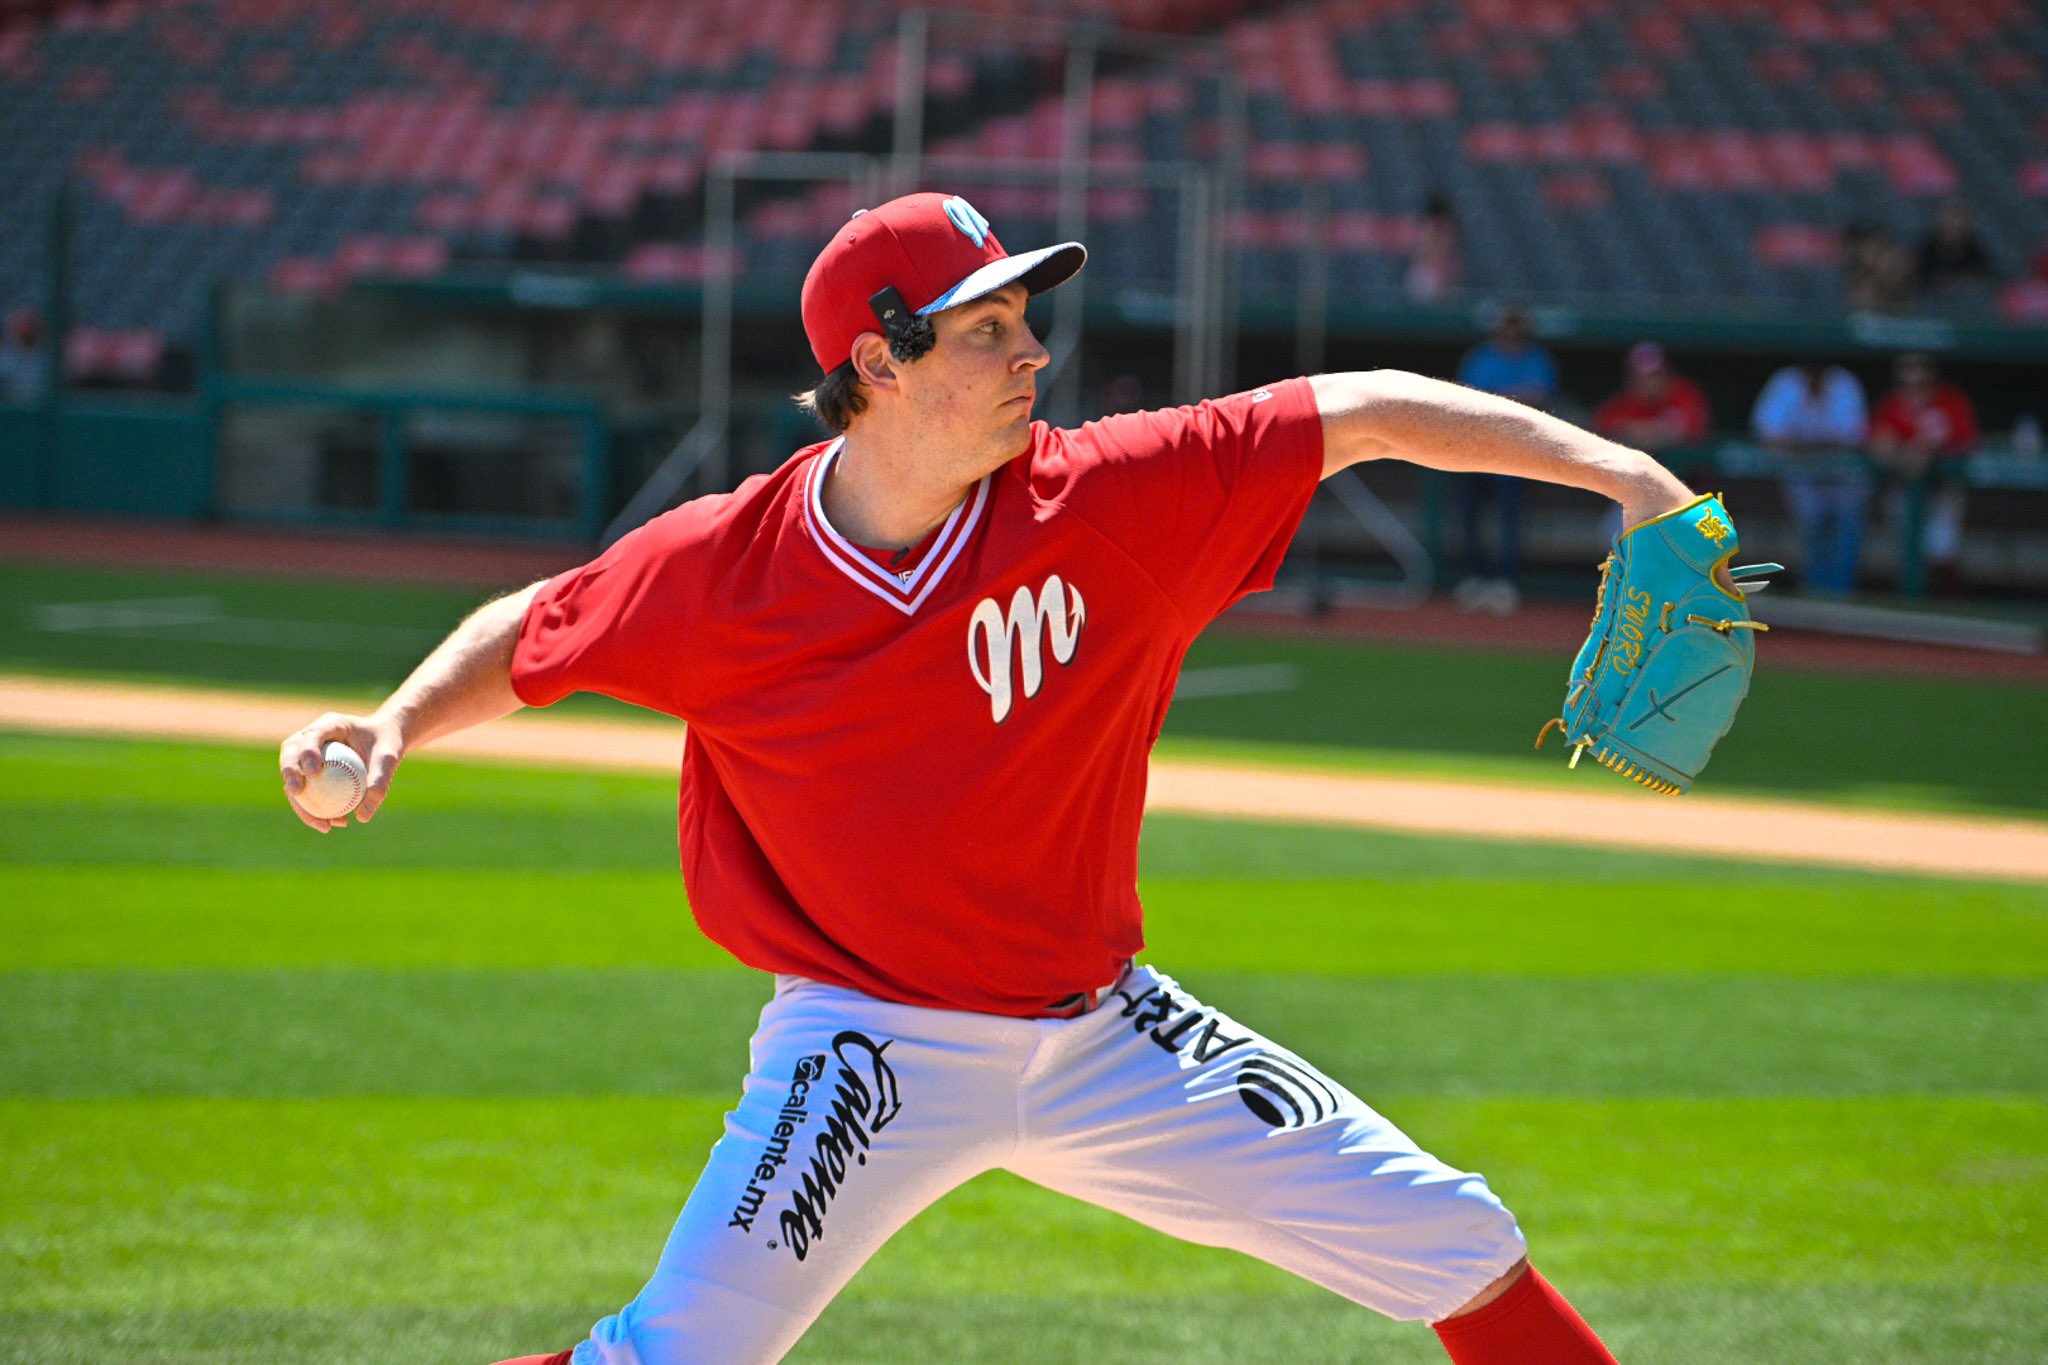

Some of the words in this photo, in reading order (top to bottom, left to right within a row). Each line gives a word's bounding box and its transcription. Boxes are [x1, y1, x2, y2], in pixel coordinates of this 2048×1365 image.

[1613, 585, 1652, 675] SWORD
[1115, 985, 1254, 1064] AT&T
[728, 1078, 809, 1234] caliente.mx
[779, 1030, 902, 1262] Caliente
